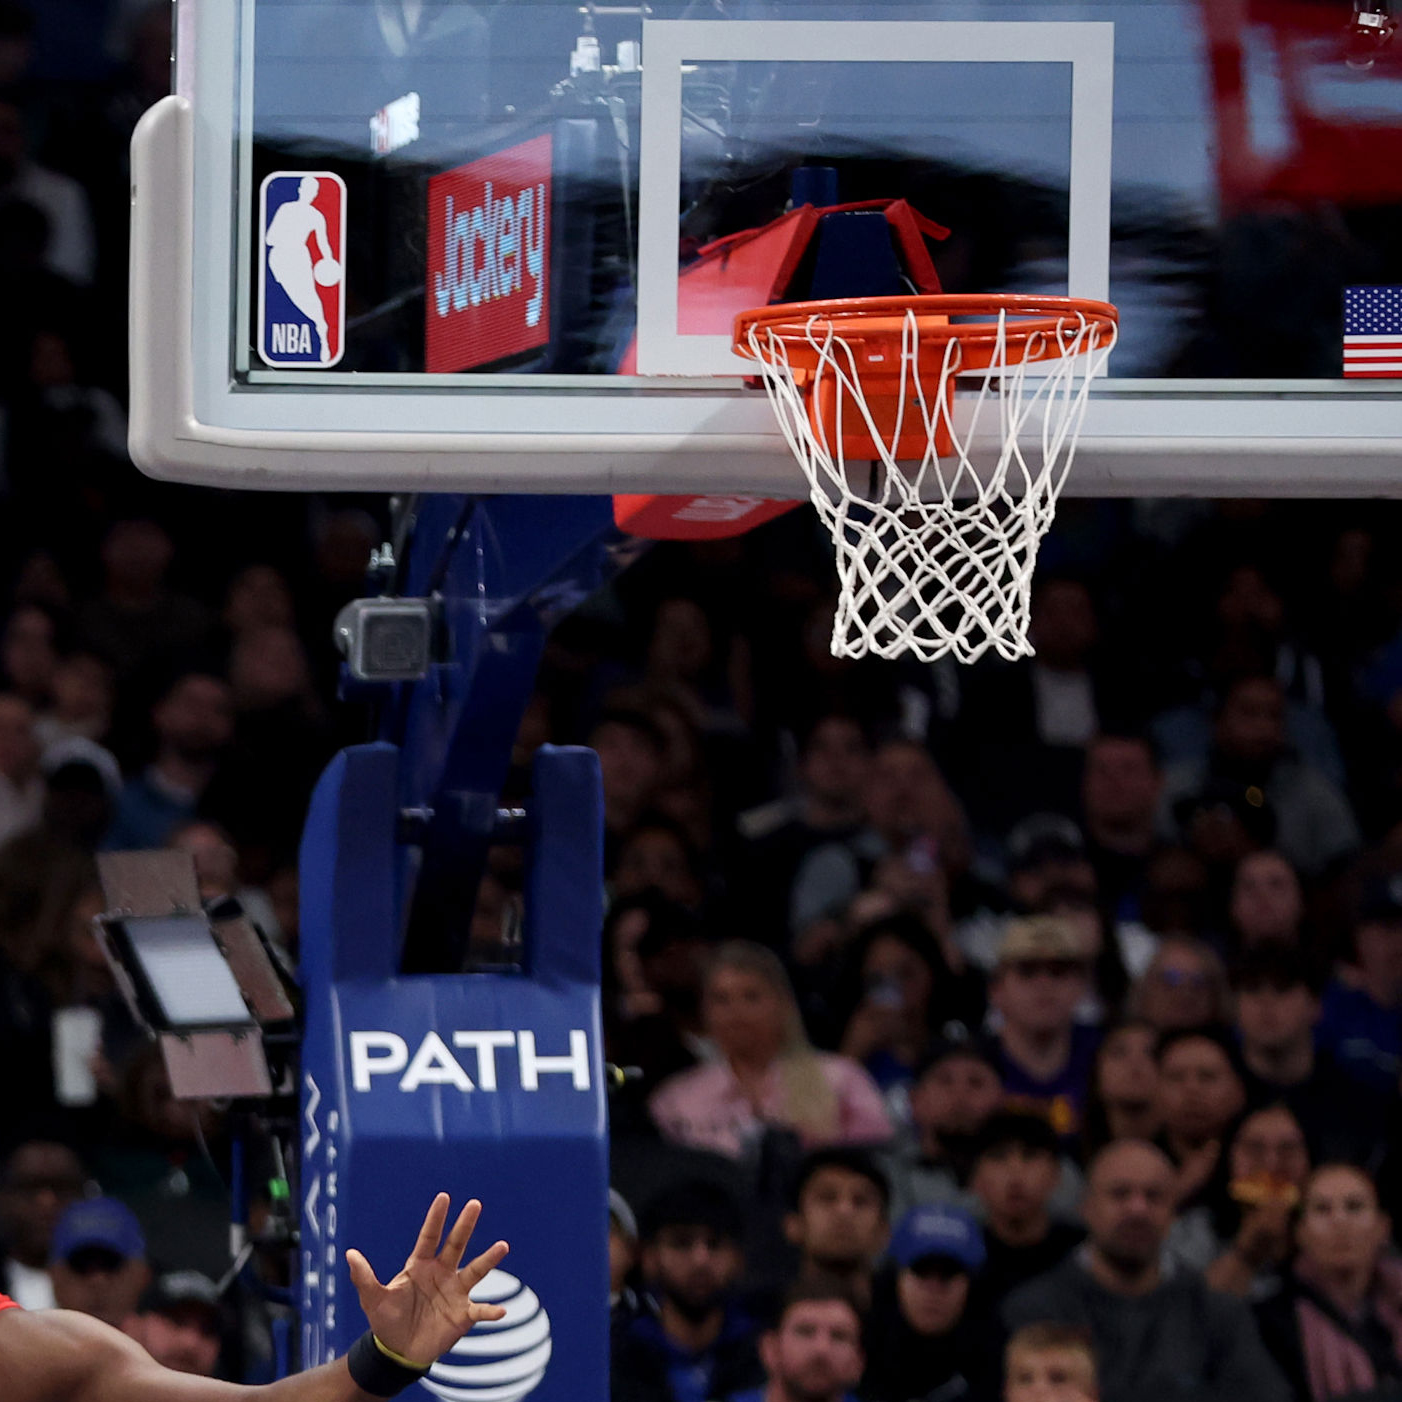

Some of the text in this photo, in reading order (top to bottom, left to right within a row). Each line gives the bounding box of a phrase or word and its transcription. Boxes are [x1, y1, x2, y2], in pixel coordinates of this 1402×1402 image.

[433, 181, 546, 328] Jockey
[271, 322, 313, 355] NBA
[350, 1029, 591, 1092] PATH
